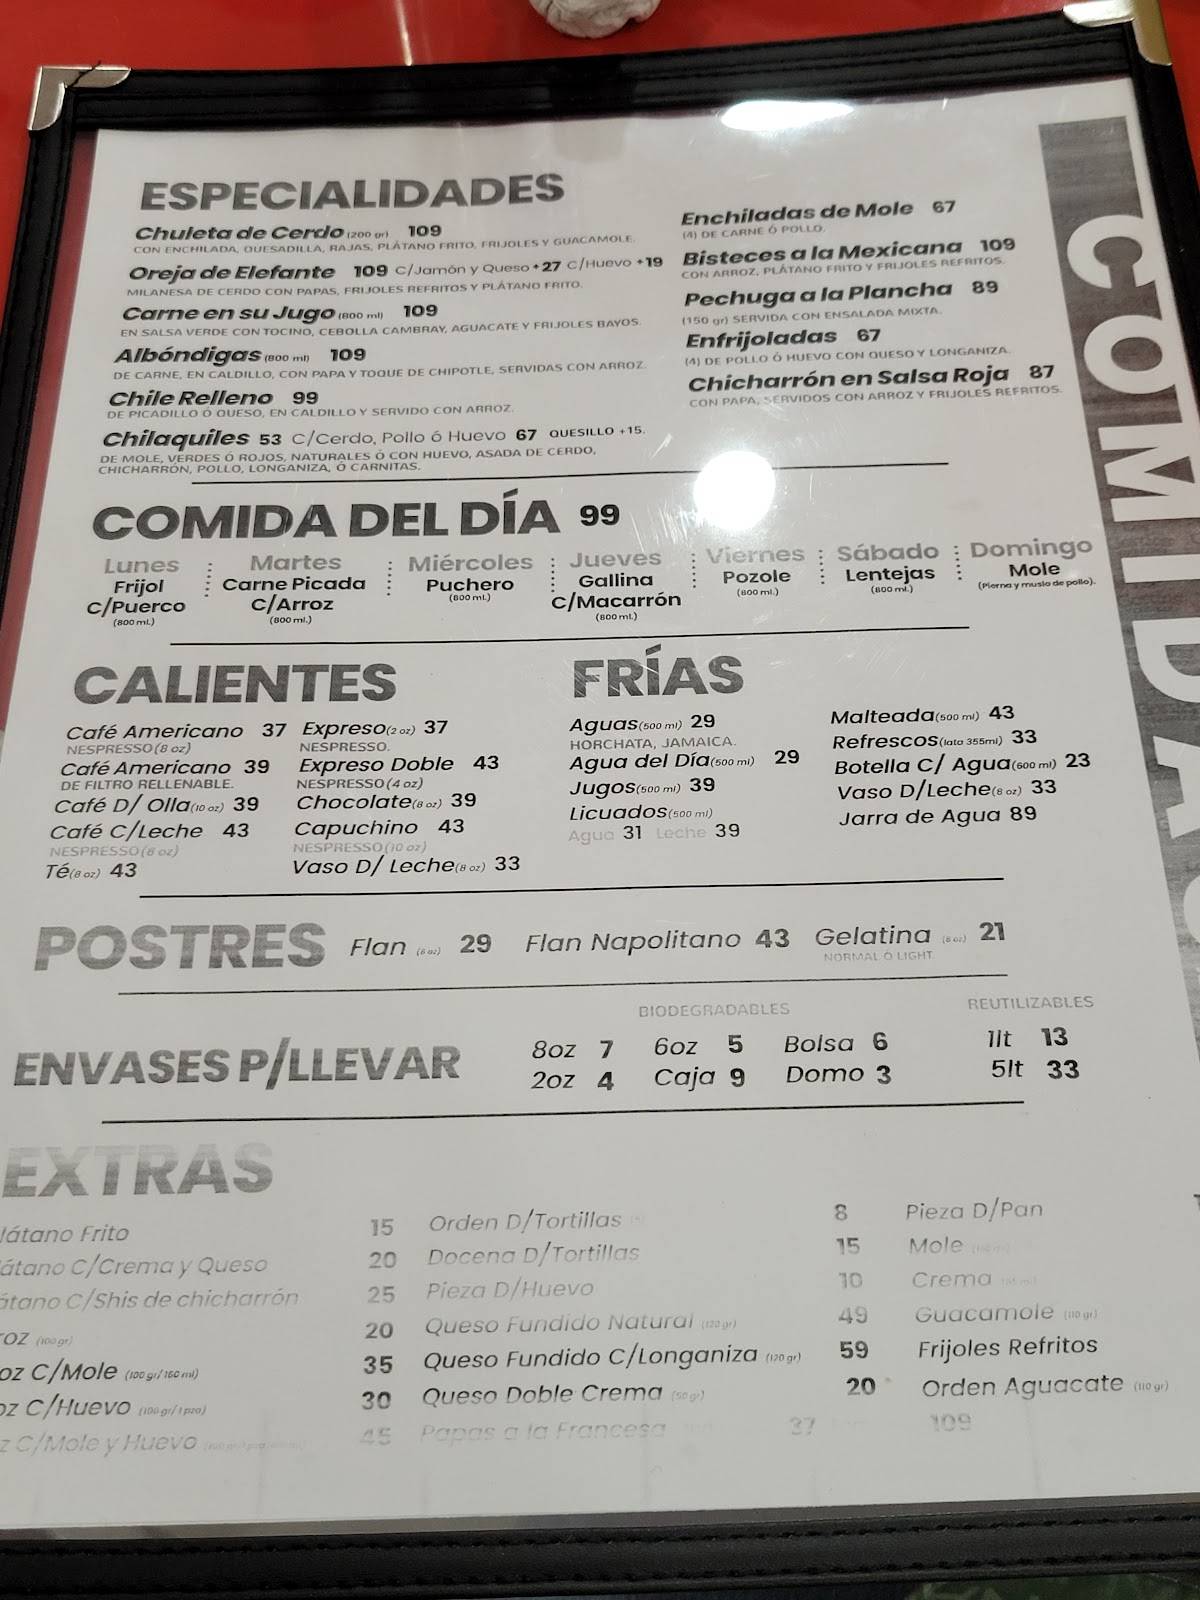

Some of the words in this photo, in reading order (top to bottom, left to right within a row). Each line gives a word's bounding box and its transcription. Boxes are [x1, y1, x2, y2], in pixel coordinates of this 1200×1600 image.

[140, 172, 565, 211] ESPECIALIDADES
[681, 206, 816, 226] Enchiladas
[819, 203, 851, 219] de
[854, 200, 914, 218] Mole
[932, 200, 956, 214] 67
[134, 226, 234, 241] Chuleta
[236, 225, 267, 240] de
[271, 225, 345, 240] Cerdo
[408, 224, 442, 237] 109
[682, 250, 786, 266] Bisteces
[790, 248, 807, 261] a
[811, 245, 835, 261] la
[838, 240, 963, 260] Mexicana
[979, 237, 1016, 252] 109
[128, 265, 197, 285] Oreja
[199, 264, 232, 280] de
[234, 264, 336, 280] Elefante
[353, 264, 388, 278] 109
[684, 289, 796, 309] Pechuga
[800, 290, 817, 303] a
[820, 286, 845, 302] la
[848, 282, 953, 301] Plancha
[972, 280, 999, 295] 89
[121, 307, 200, 321] Carne
[203, 308, 235, 320] en
[238, 308, 270, 320] su
[272, 305, 336, 325] Jugo
[403, 304, 438, 318] 109
[141, 329, 182, 337] SALSA
[186, 328, 228, 336] VERDE
[232, 328, 260, 336] CON
[318, 327, 378, 336] CEBOLLA
[686, 329, 837, 352] Enfrijoladas
[856, 328, 881, 342] 67
[113, 346, 262, 367] Albóndigas
[330, 348, 366, 362] 109
[688, 370, 836, 392] Chicharrón
[840, 374, 873, 386] en
[877, 368, 949, 385] Salsa
[953, 364, 1010, 388] Roja
[1029, 364, 1055, 379] 87
[108, 389, 175, 407] Chile
[178, 390, 274, 406] Relleno
[292, 391, 319, 405] 99
[102, 428, 251, 452] Chilaquiles
[259, 432, 282, 446] 53
[292, 429, 376, 447] C/Cerdo,
[382, 431, 425, 444] Pollo
[431, 430, 442, 442] ó
[448, 430, 506, 442] Huevo
[516, 428, 537, 441] 67
[549, 427, 614, 438] QUESILLO
[619, 425, 645, 435] +15.
[98, 460, 192, 475] CHICHARRÓN,
[197, 465, 244, 474] POLLO,
[249, 463, 331, 473] LONGANIZA,
[350, 461, 421, 472] CARNITAS.
[92, 504, 338, 540] COMIDA
[349, 502, 449, 537] DEL
[460, 488, 561, 536] DÍA
[580, 504, 620, 526] 99
[706, 546, 805, 564] Viernes
[837, 543, 940, 562] Sábado
[970, 538, 1093, 560] Domingo
[104, 558, 179, 574] Lunes
[250, 555, 342, 571] Martes
[409, 554, 533, 572] Miércoles
[569, 552, 662, 568] Jueves
[1008, 562, 1061, 577] Mole
[222, 578, 288, 591] Carne
[292, 576, 366, 591] Picada
[427, 578, 514, 592] Puchero
[579, 572, 653, 588] Gallina
[723, 569, 791, 584] Pozole
[845, 565, 935, 586] Lentejas
[114, 579, 164, 598] Frijol
[86, 596, 186, 618] C/Puerco
[251, 594, 334, 615] C/Arroz
[551, 589, 681, 612] C/Macarrón
[573, 643, 744, 698] FRÍAS
[74, 663, 397, 705] CALIENTES
[66, 724, 118, 741] Café
[122, 723, 244, 739] Americano
[262, 723, 287, 737] 37
[570, 738, 656, 750] HORCHATA,
[661, 736, 736, 748] JAMAICA.
[298, 758, 384, 777] Expreso
[391, 756, 454, 772] Doble
[473, 755, 499, 770] 43
[838, 812, 898, 826] Jarra
[905, 809, 935, 824] de
[940, 808, 1000, 827] Agua
[1010, 806, 1037, 821] 89
[294, 819, 418, 840] Capuchino
[438, 819, 464, 834] 43
[460, 934, 492, 953] 29
[526, 933, 581, 952] Flan
[591, 930, 741, 956] Napolitano
[755, 928, 790, 948] 43
[815, 925, 931, 945] Gelatina
[979, 922, 1005, 941] 21
[34, 922, 326, 971] POSTRES
[350, 937, 406, 956] Flan
[639, 1003, 790, 1017] BIODEGRADABLES
[968, 996, 1094, 1010] REUTILIZABLES
[654, 1037, 698, 1056] 6oz
[728, 1034, 743, 1053] 5
[784, 1034, 854, 1053] Bolsa
[873, 1032, 888, 1051] 6
[1040, 1026, 1068, 1047] 13
[532, 1040, 576, 1059] 8oz
[600, 1040, 614, 1059] 7
[13, 1048, 230, 1086] ENVASES
[238, 1037, 461, 1091] P/LLEVAR
[992, 1059, 1024, 1078] 5lt
[1046, 1059, 1080, 1080] 33
[530, 1071, 576, 1089] 2oz
[597, 1071, 614, 1091] 4
[654, 1066, 716, 1092] Caja
[730, 1067, 745, 1087] 9
[786, 1066, 864, 1083] Domo
[876, 1065, 892, 1085] 3
[2, 1144, 273, 1198] EXTRAS
[906, 1203, 964, 1220] Pieza
[973, 1197, 1043, 1222] D/Pan
[424, 1352, 498, 1372] Queso
[506, 1348, 600, 1368] Fundido
[608, 1342, 758, 1370] C/Longaniza
[840, 1340, 869, 1360] 59
[919, 1339, 1000, 1364] Frijoles
[1009, 1336, 1098, 1356] Refritos
[30, 1357, 118, 1384] C/Mole
[363, 1355, 393, 1375] 35
[922, 1378, 995, 1397] Orden
[1004, 1374, 1124, 1400] Aguacate
[26, 1393, 131, 1420] C/Huevo
[361, 1390, 392, 1410] 30
